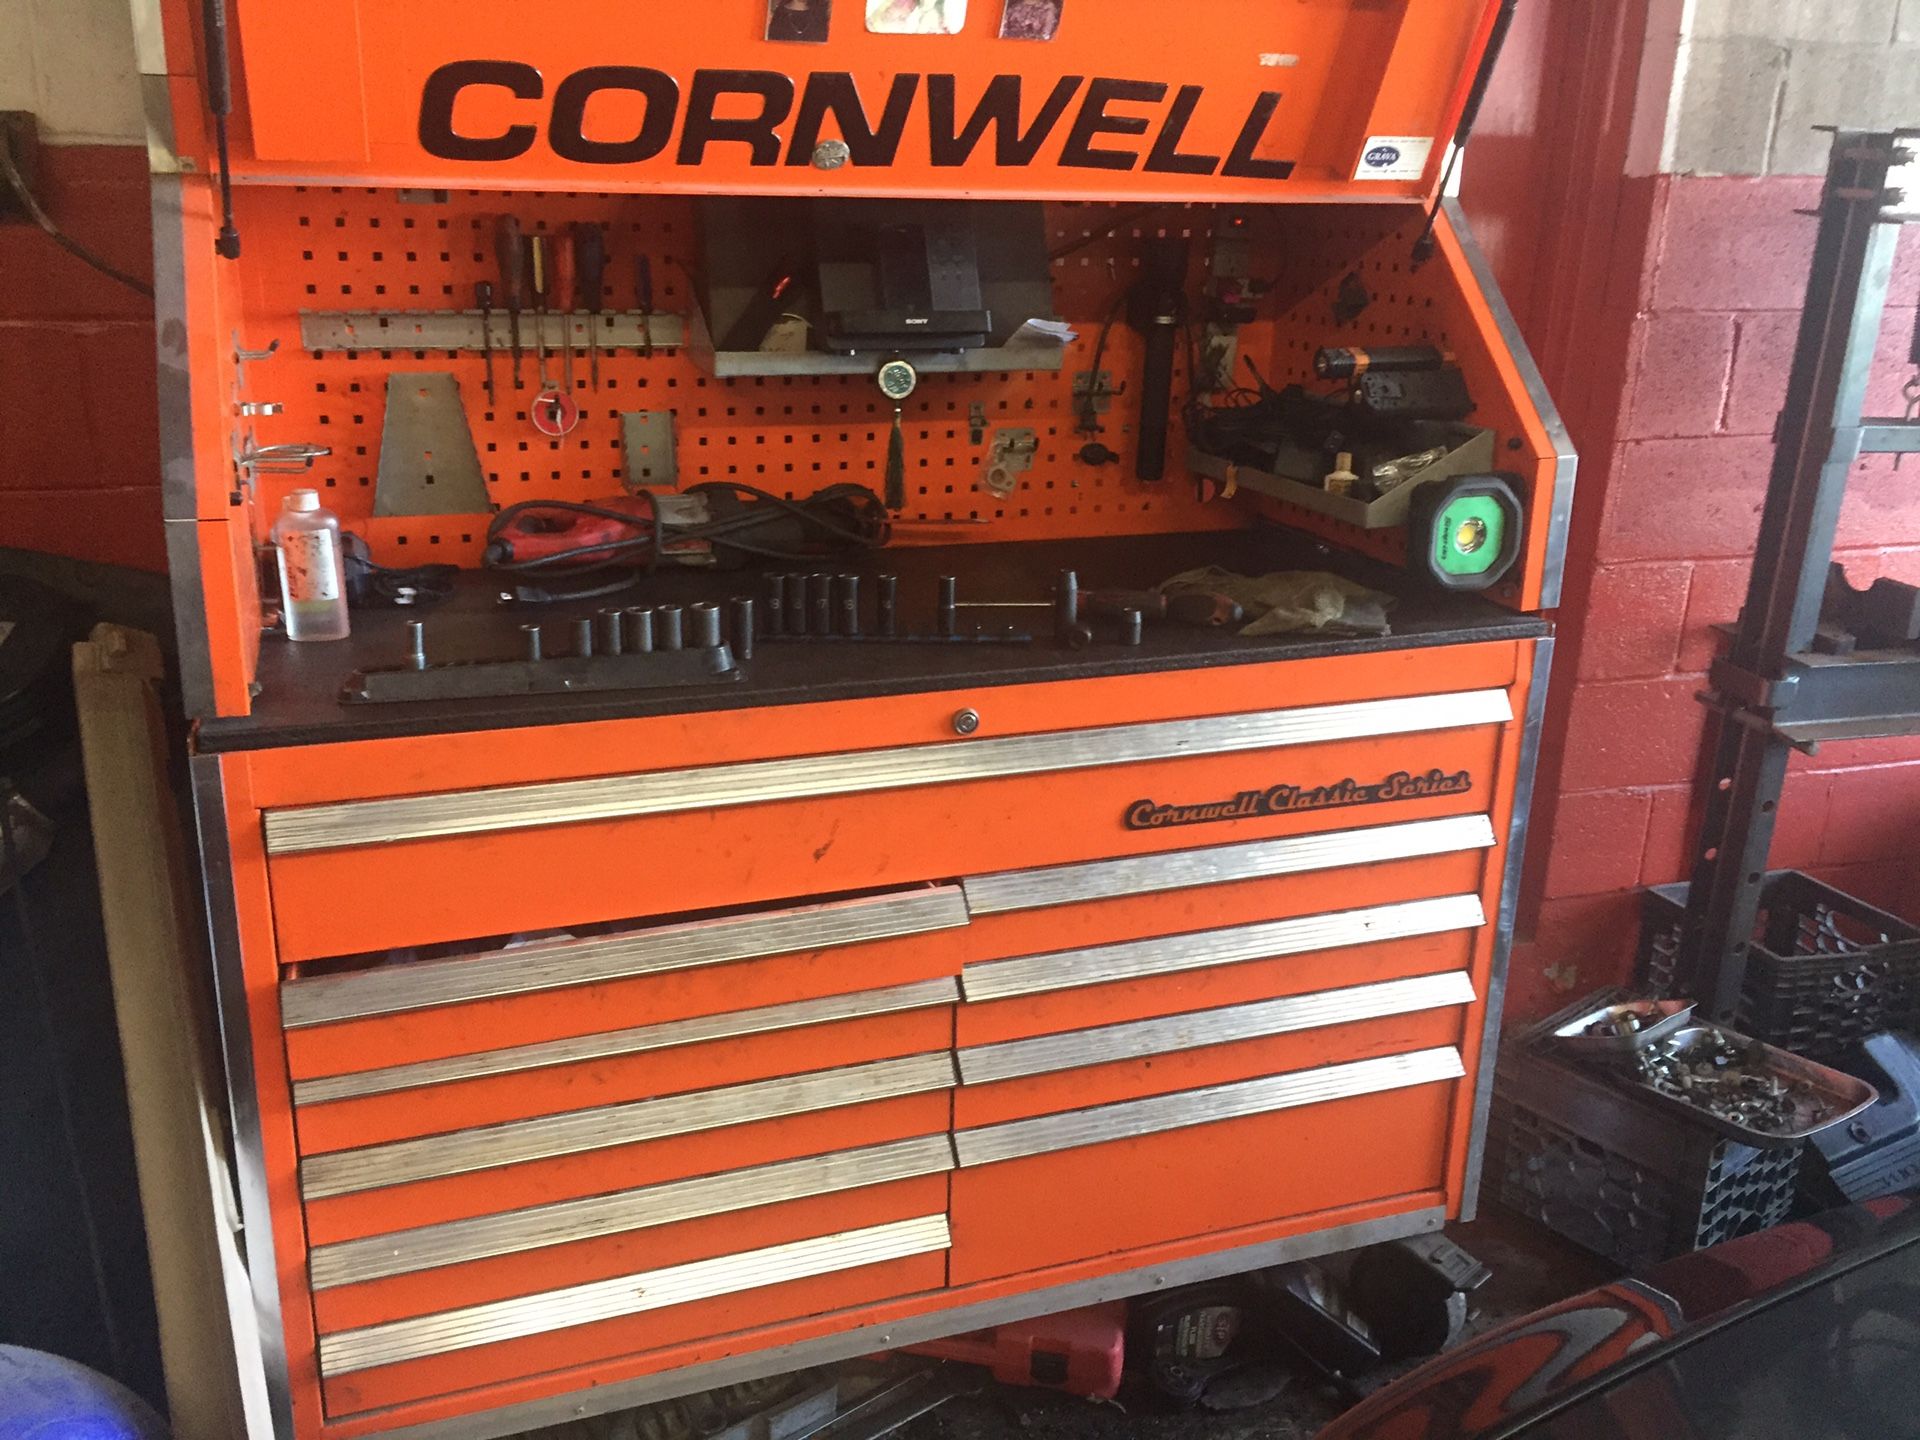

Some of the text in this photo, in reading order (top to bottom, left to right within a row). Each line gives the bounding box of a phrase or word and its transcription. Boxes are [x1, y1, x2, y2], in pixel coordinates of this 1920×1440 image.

[418, 60, 1296, 180] CORNWELL
[1130, 772, 1471, 828] Cornwell Classic Series
